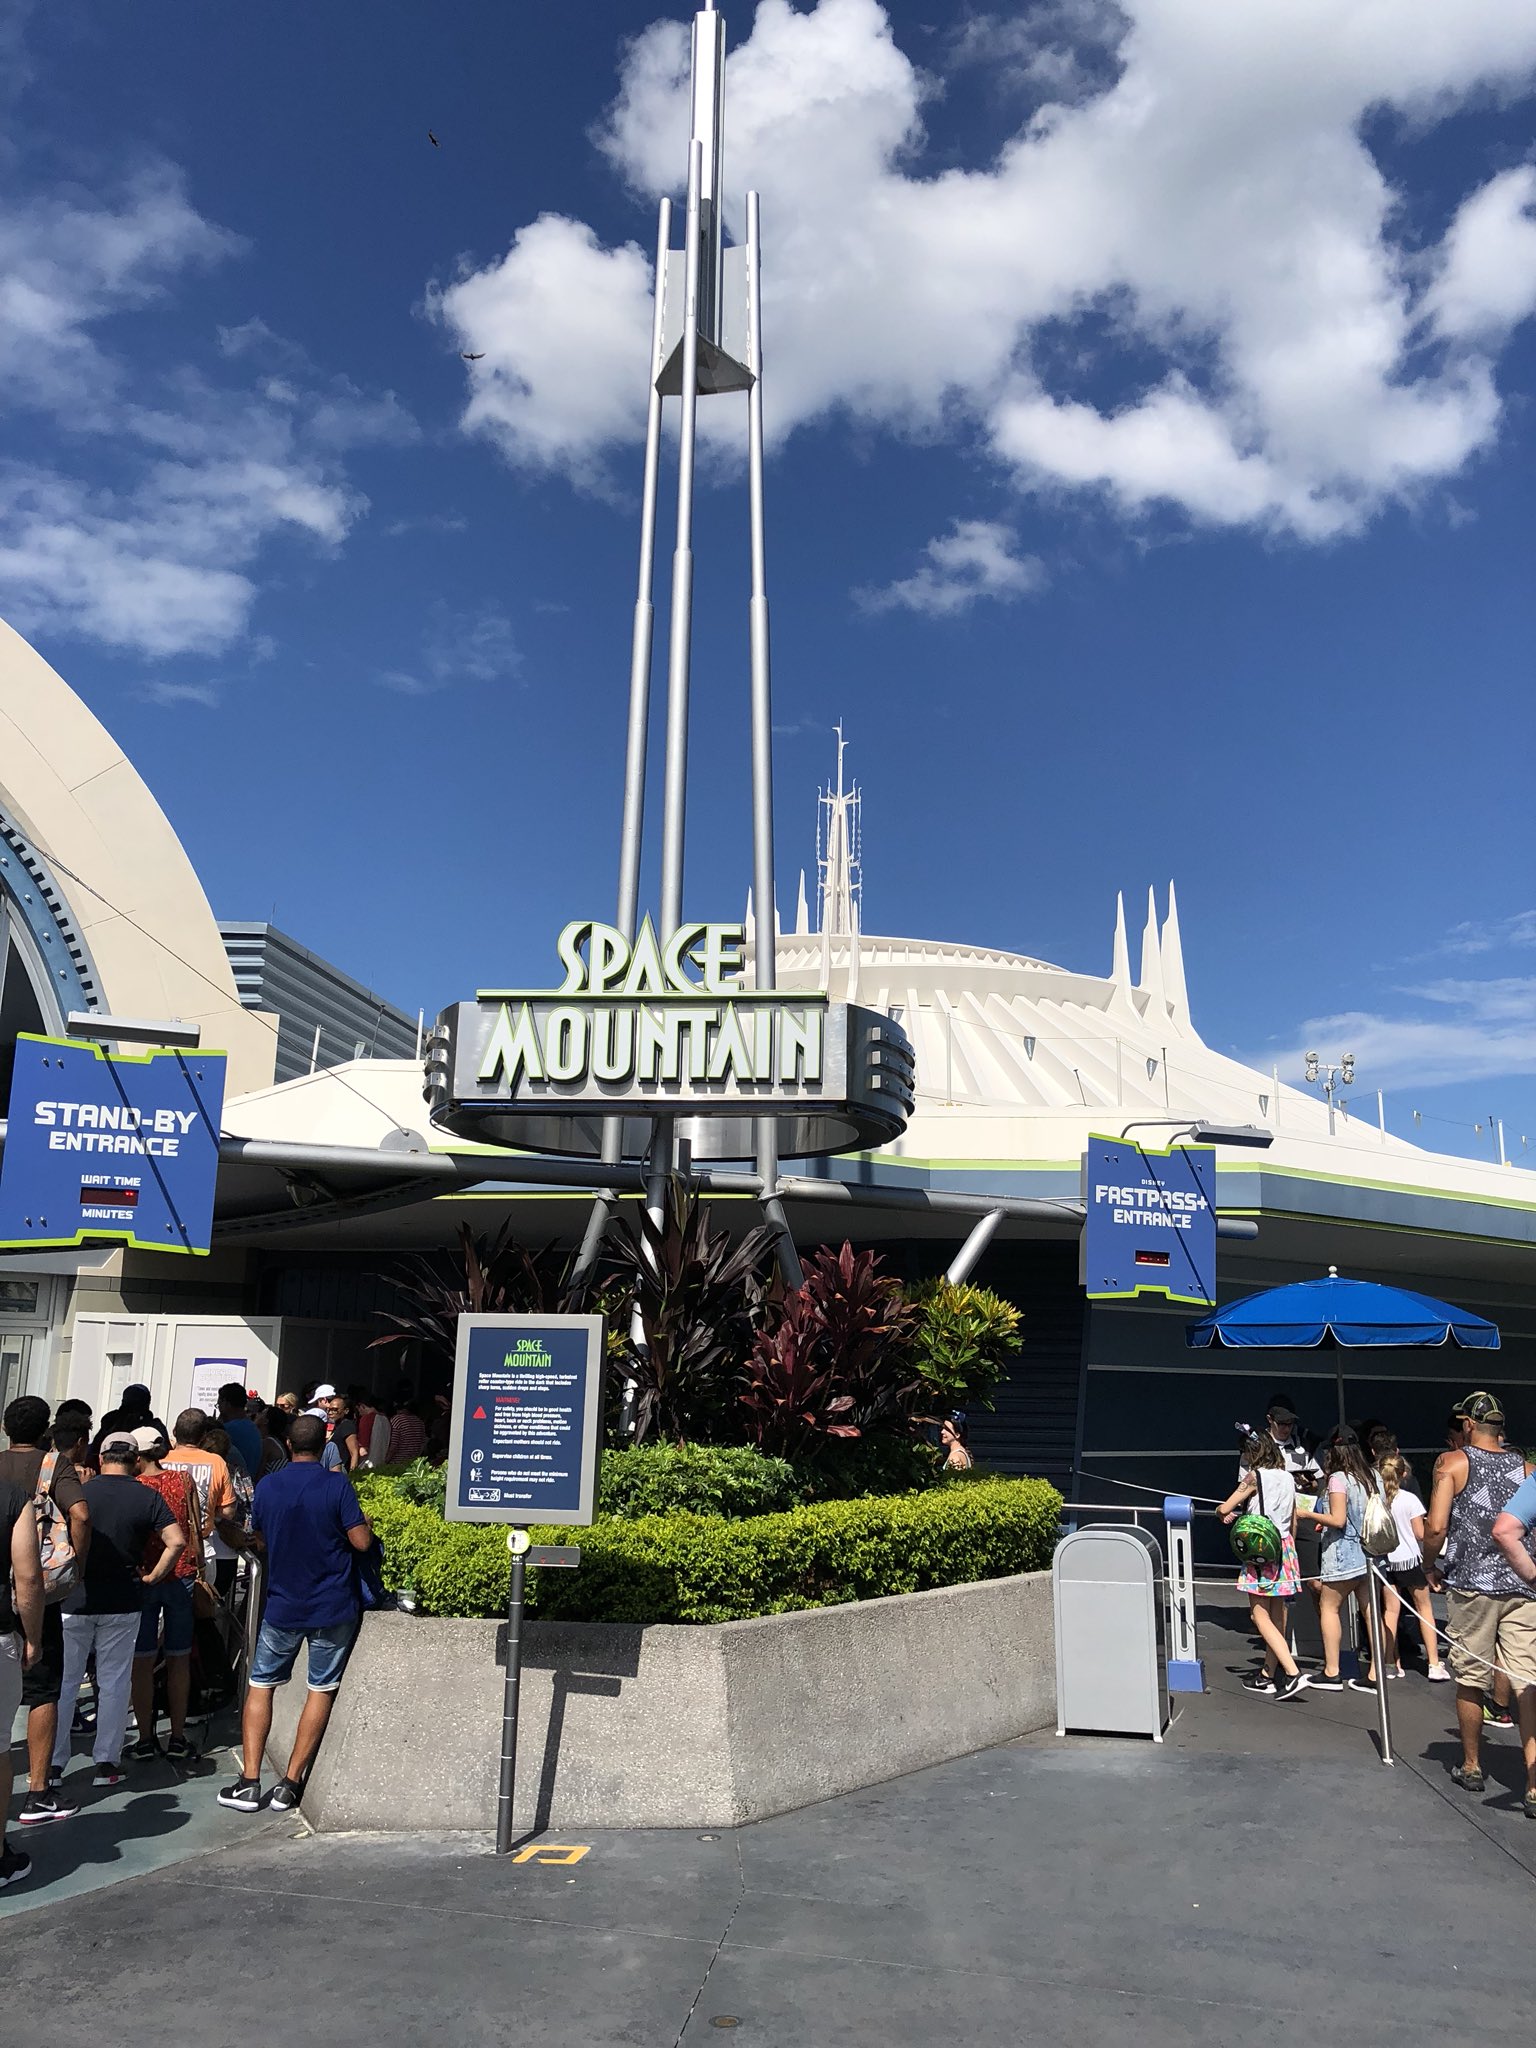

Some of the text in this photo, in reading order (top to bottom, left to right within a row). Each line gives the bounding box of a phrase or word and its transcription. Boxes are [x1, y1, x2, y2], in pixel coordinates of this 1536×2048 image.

[556, 909, 745, 993] SPACE
[477, 1000, 824, 1097] MOUNTAIN
[34, 1101, 198, 1134] STAND-BY
[49, 1131, 180, 1157] ENTRANCE
[81, 1174, 141, 1187] WAIT TIME
[1141, 1179, 1166, 1187] DISNEY
[1095, 1185, 1208, 1211] FASTPASS+
[82, 1208, 134, 1220] MINUTES
[1113, 1209, 1192, 1229] ENTRANCE
[516, 1339, 543, 1351] SPACE
[504, 1352, 552, 1367] MOUNTAIN
[192, 1465, 211, 1490] UP!
